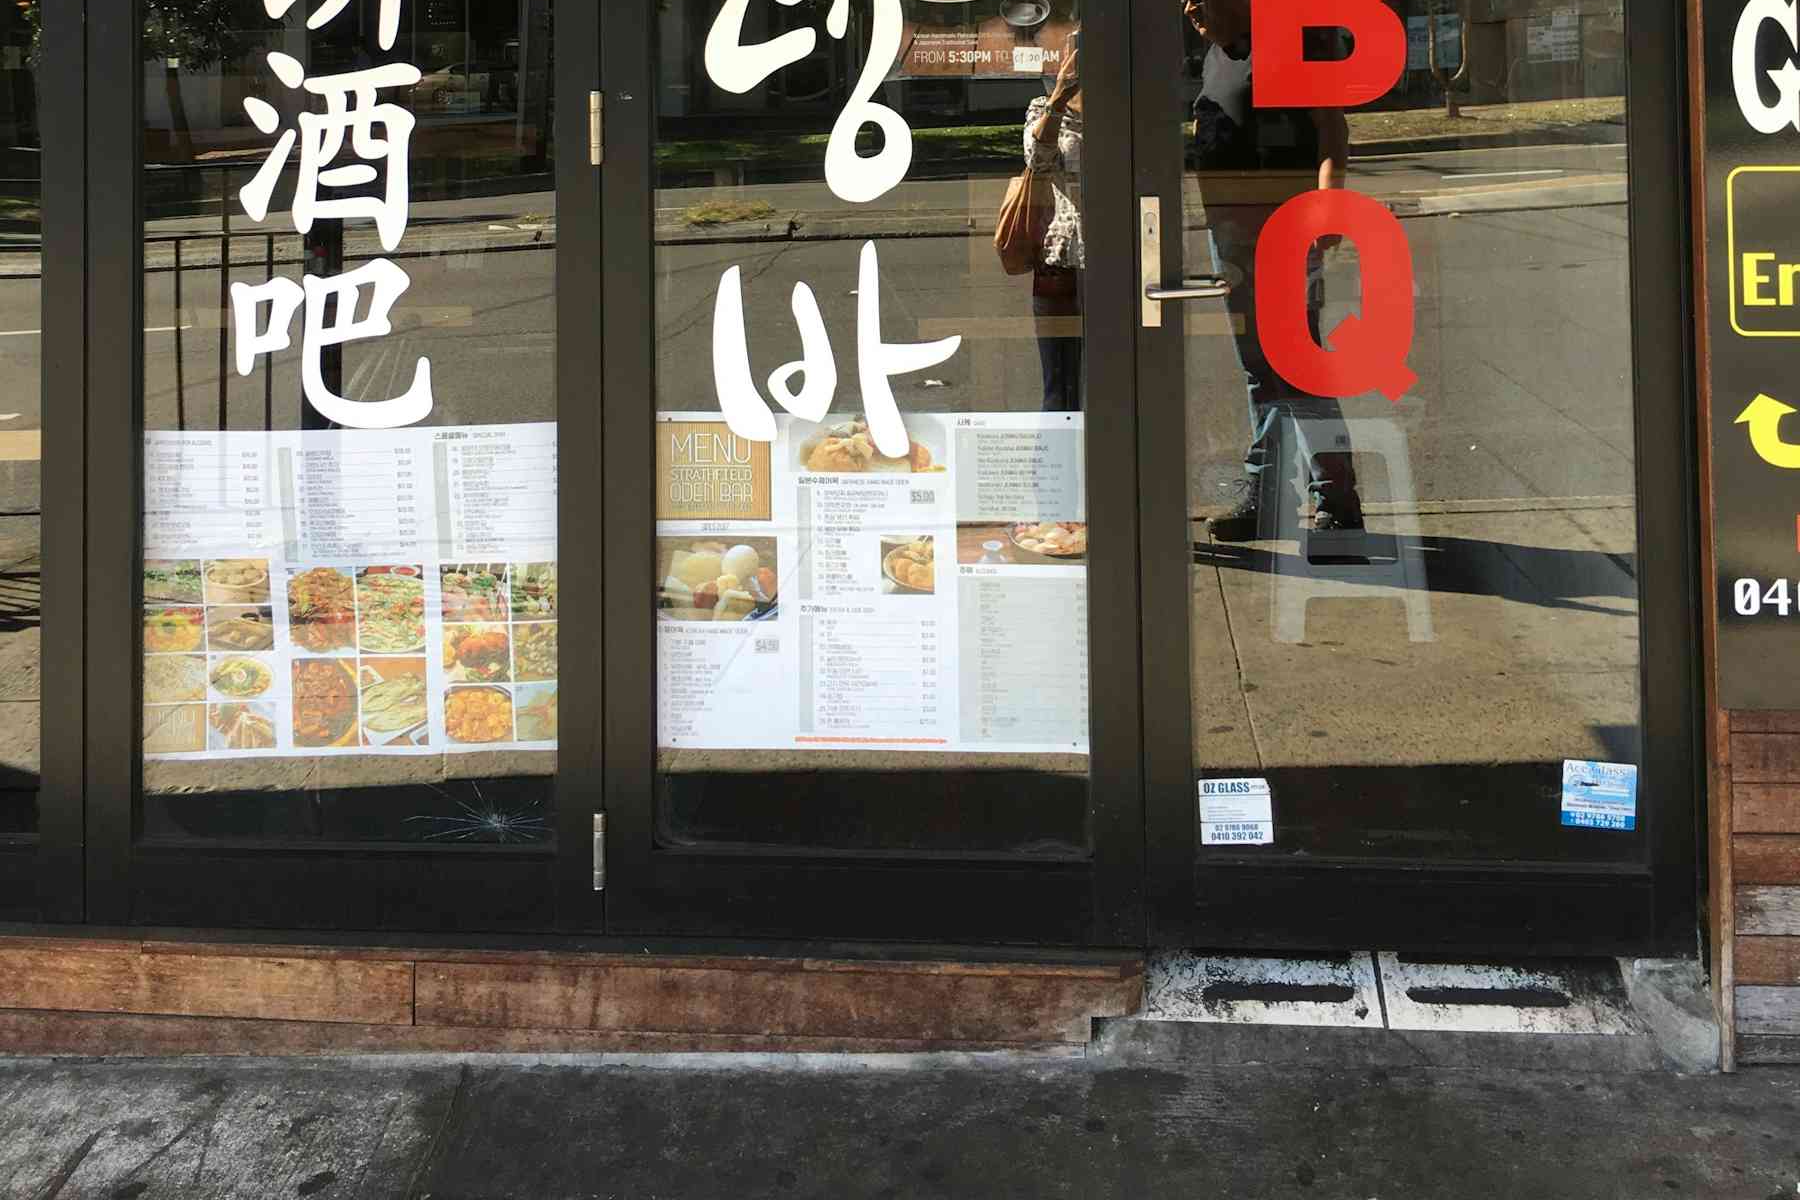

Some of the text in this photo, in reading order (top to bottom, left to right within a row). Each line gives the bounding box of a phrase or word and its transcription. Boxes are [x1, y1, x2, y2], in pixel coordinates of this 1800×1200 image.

[913, 50, 945, 64] FROM
[947, 49, 992, 64] 5:30PM
[995, 50, 1009, 64] TO
[1042, 49, 1060, 63] AM
[671, 432, 752, 464] MENU
[671, 468, 752, 481] STRATHFIELD
[670, 482, 752, 503] ODEN BAR
[1733, 569, 1800, 617] 04
[1203, 782, 1216, 794] OZ
[1217, 781, 1250, 794] GLASS
[1211, 832, 1230, 841] 0410
[1231, 831, 1247, 841] 392
